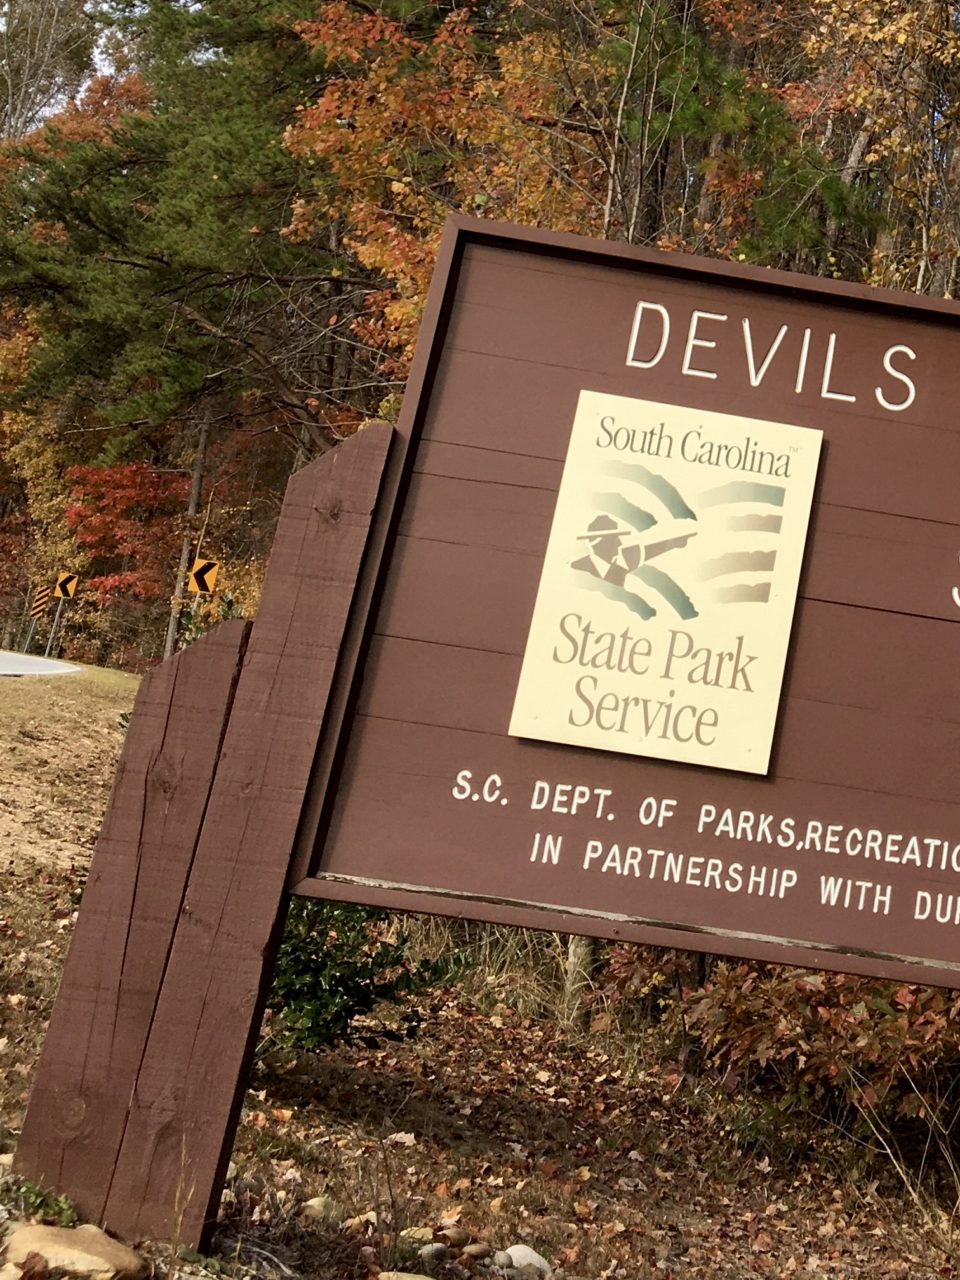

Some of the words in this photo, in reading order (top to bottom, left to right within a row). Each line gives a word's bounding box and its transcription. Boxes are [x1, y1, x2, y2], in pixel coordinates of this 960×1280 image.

[625, 300, 917, 411] DEVILS
[596, 415, 674, 459] South
[681, 426, 791, 479] Carolina
[552, 612, 652, 676] State
[659, 628, 759, 694] Park
[568, 675, 719, 747] Service
[452, 770, 508, 806] S.C.
[530, 780, 615, 821] DEPT.
[638, 796, 678, 828] OF
[530, 833, 563, 865] IN
[583, 840, 798, 899] PARTNERSHIP
[819, 875, 892, 915] WITH
